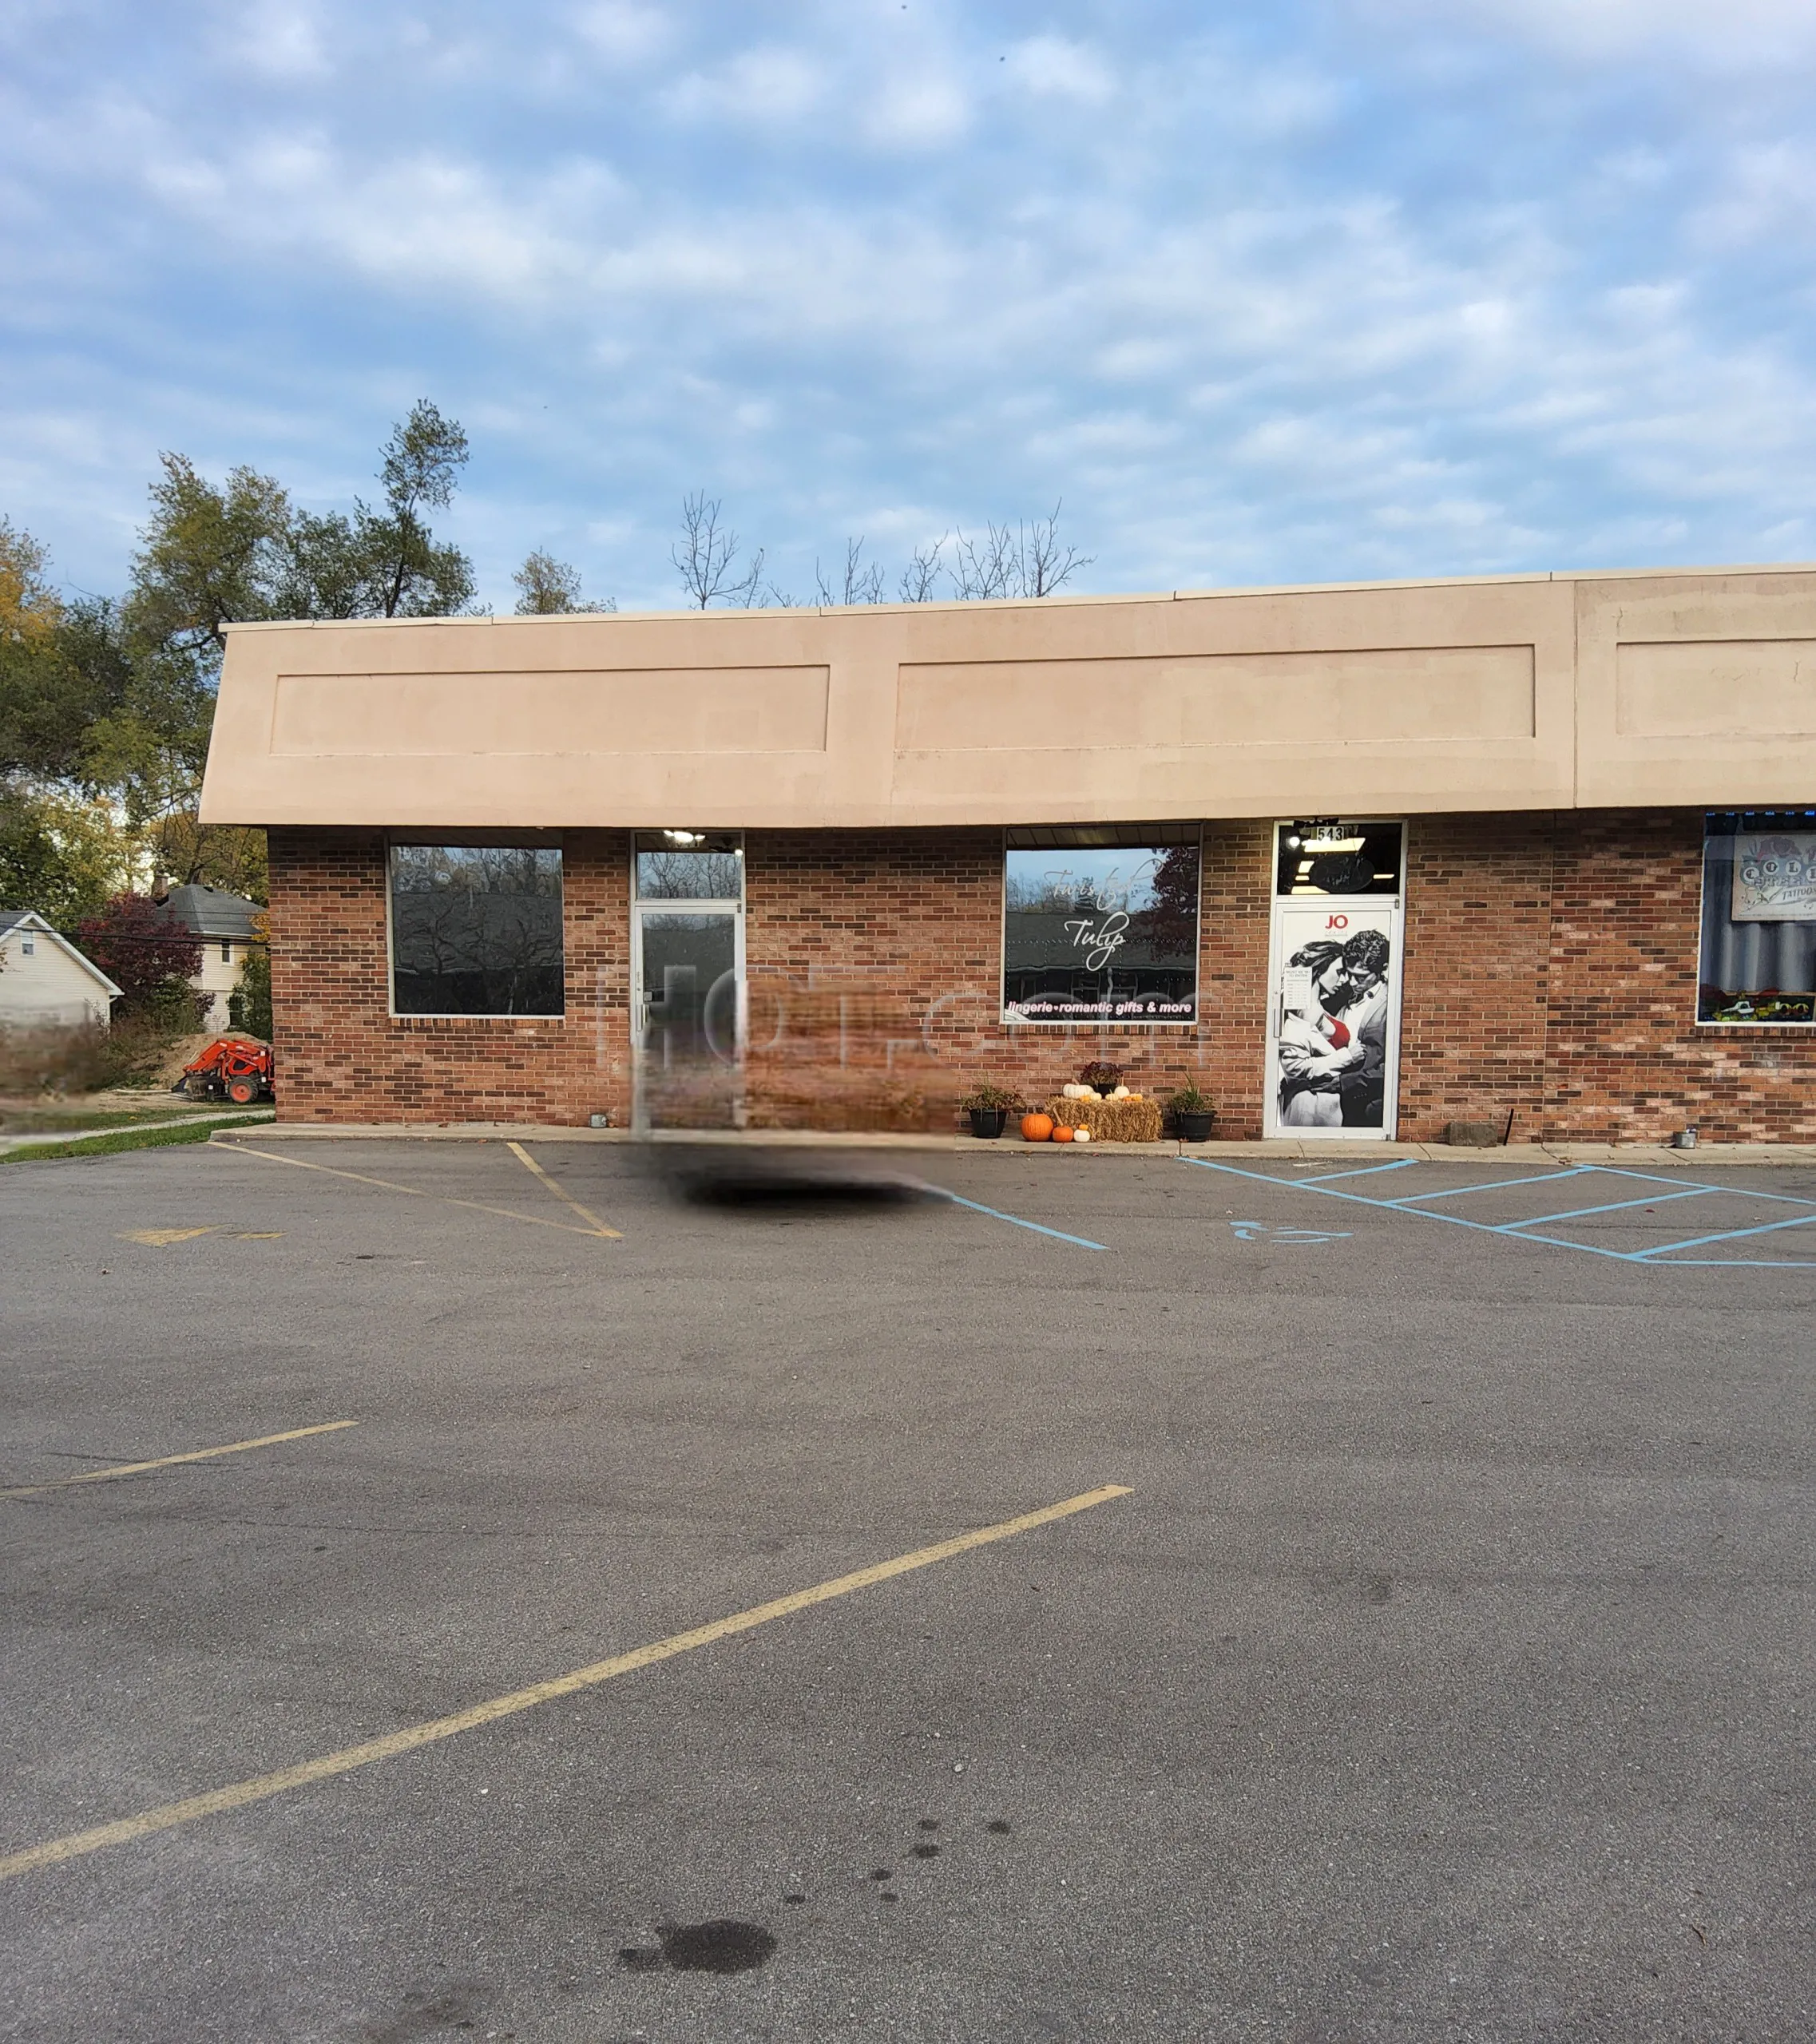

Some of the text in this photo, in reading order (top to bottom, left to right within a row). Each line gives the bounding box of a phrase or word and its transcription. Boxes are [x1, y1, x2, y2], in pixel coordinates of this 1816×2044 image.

[1318, 827, 1343, 841] 543
[1044, 858, 1164, 911] Twisted
[1325, 914, 1349, 929] JO
[1064, 911, 1130, 972] Tulip
[1008, 1000, 1192, 1016] lingerie romantic gifts & more
